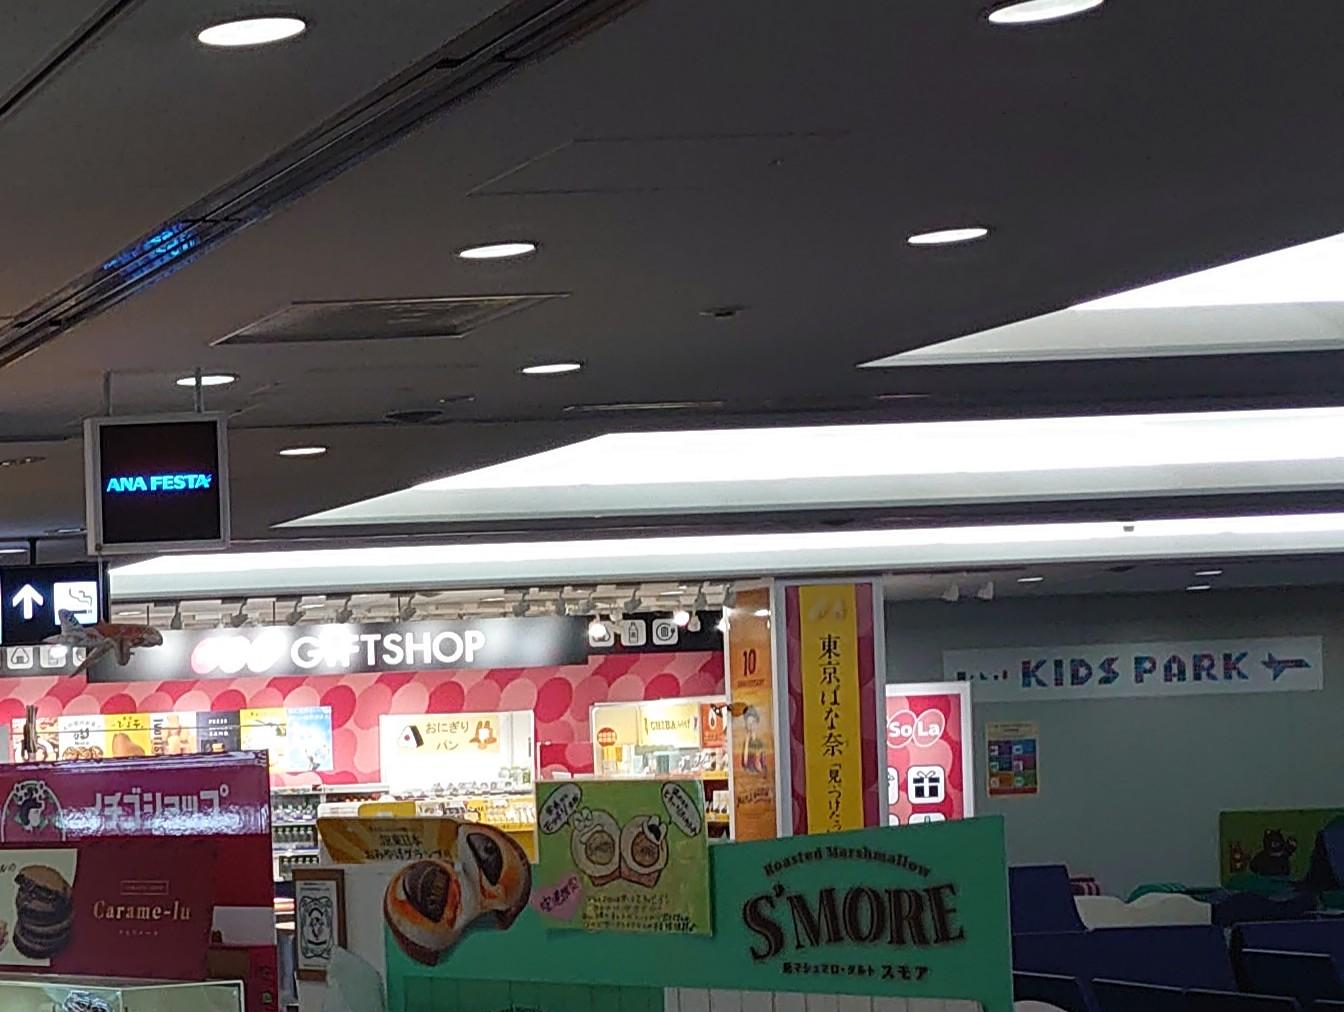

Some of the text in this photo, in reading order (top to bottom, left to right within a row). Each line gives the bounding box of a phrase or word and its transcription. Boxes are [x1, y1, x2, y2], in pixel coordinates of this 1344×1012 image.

[107, 474, 213, 492] ANA FESTA
[743, 648, 757, 677] 10
[1021, 651, 1250, 688] KIDS PARK
[818, 634, 845, 757] 東京ばな奈
[425, 720, 471, 735] おにぎり
[890, 721, 913, 738] So
[917, 720, 941, 737] La
[436, 738, 460, 752] パン
[764, 846, 931, 878] Roasted Marshmallow
[93, 901, 192, 920] Carame-lu
[743, 881, 965, 961] S'MORE
[881, 965, 929, 981] スモア
